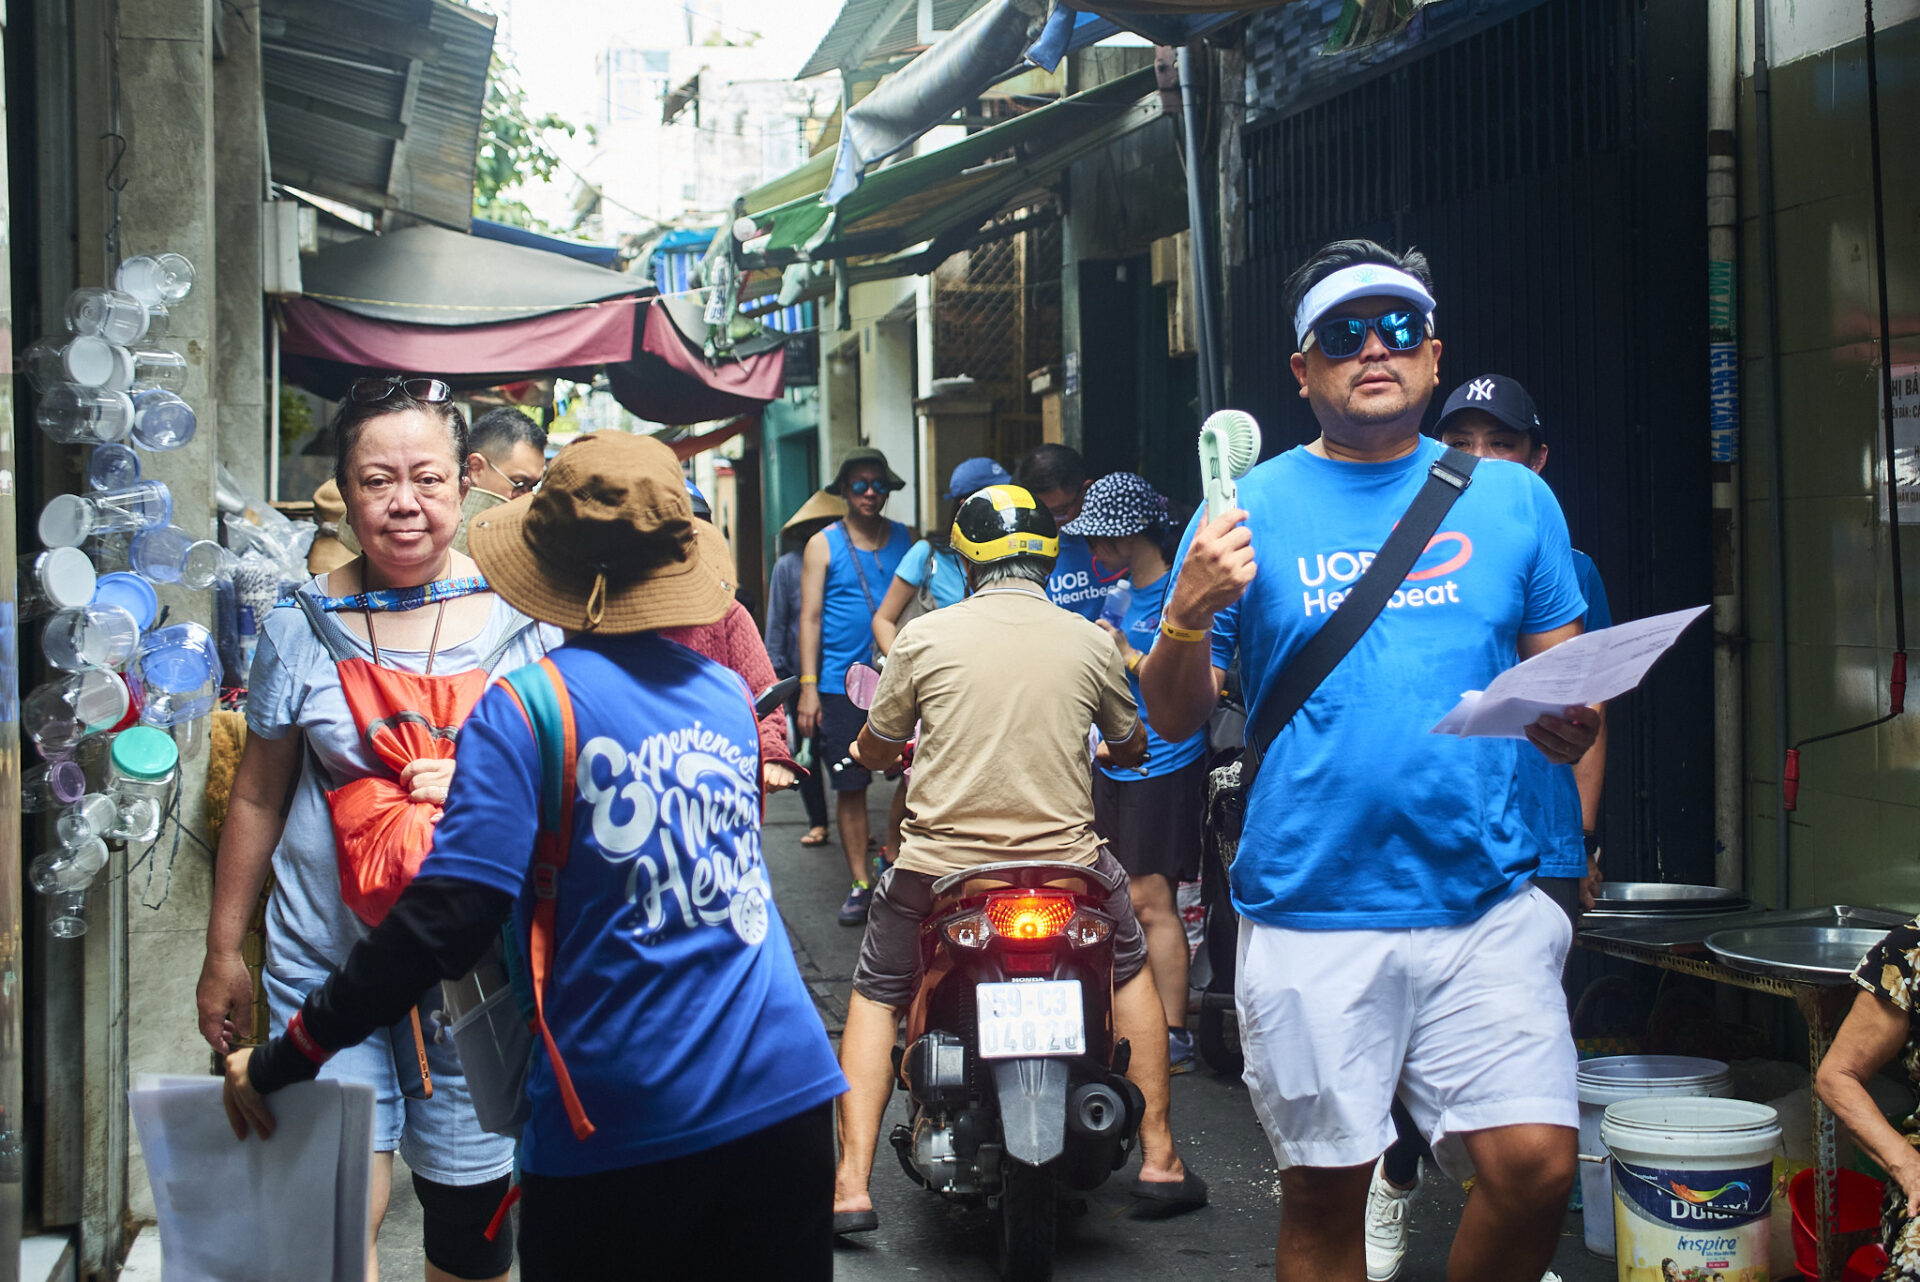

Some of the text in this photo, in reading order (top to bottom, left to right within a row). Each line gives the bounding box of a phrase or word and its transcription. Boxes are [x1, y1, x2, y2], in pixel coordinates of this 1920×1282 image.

[1466, 378, 1495, 401] NY
[1050, 571, 1089, 593] UOB
[1052, 584, 1116, 605] Heartbe
[1303, 580, 1459, 617] Hebeat
[991, 987, 1067, 1017] 59-C3
[1677, 1235, 1737, 1257] Inspire
